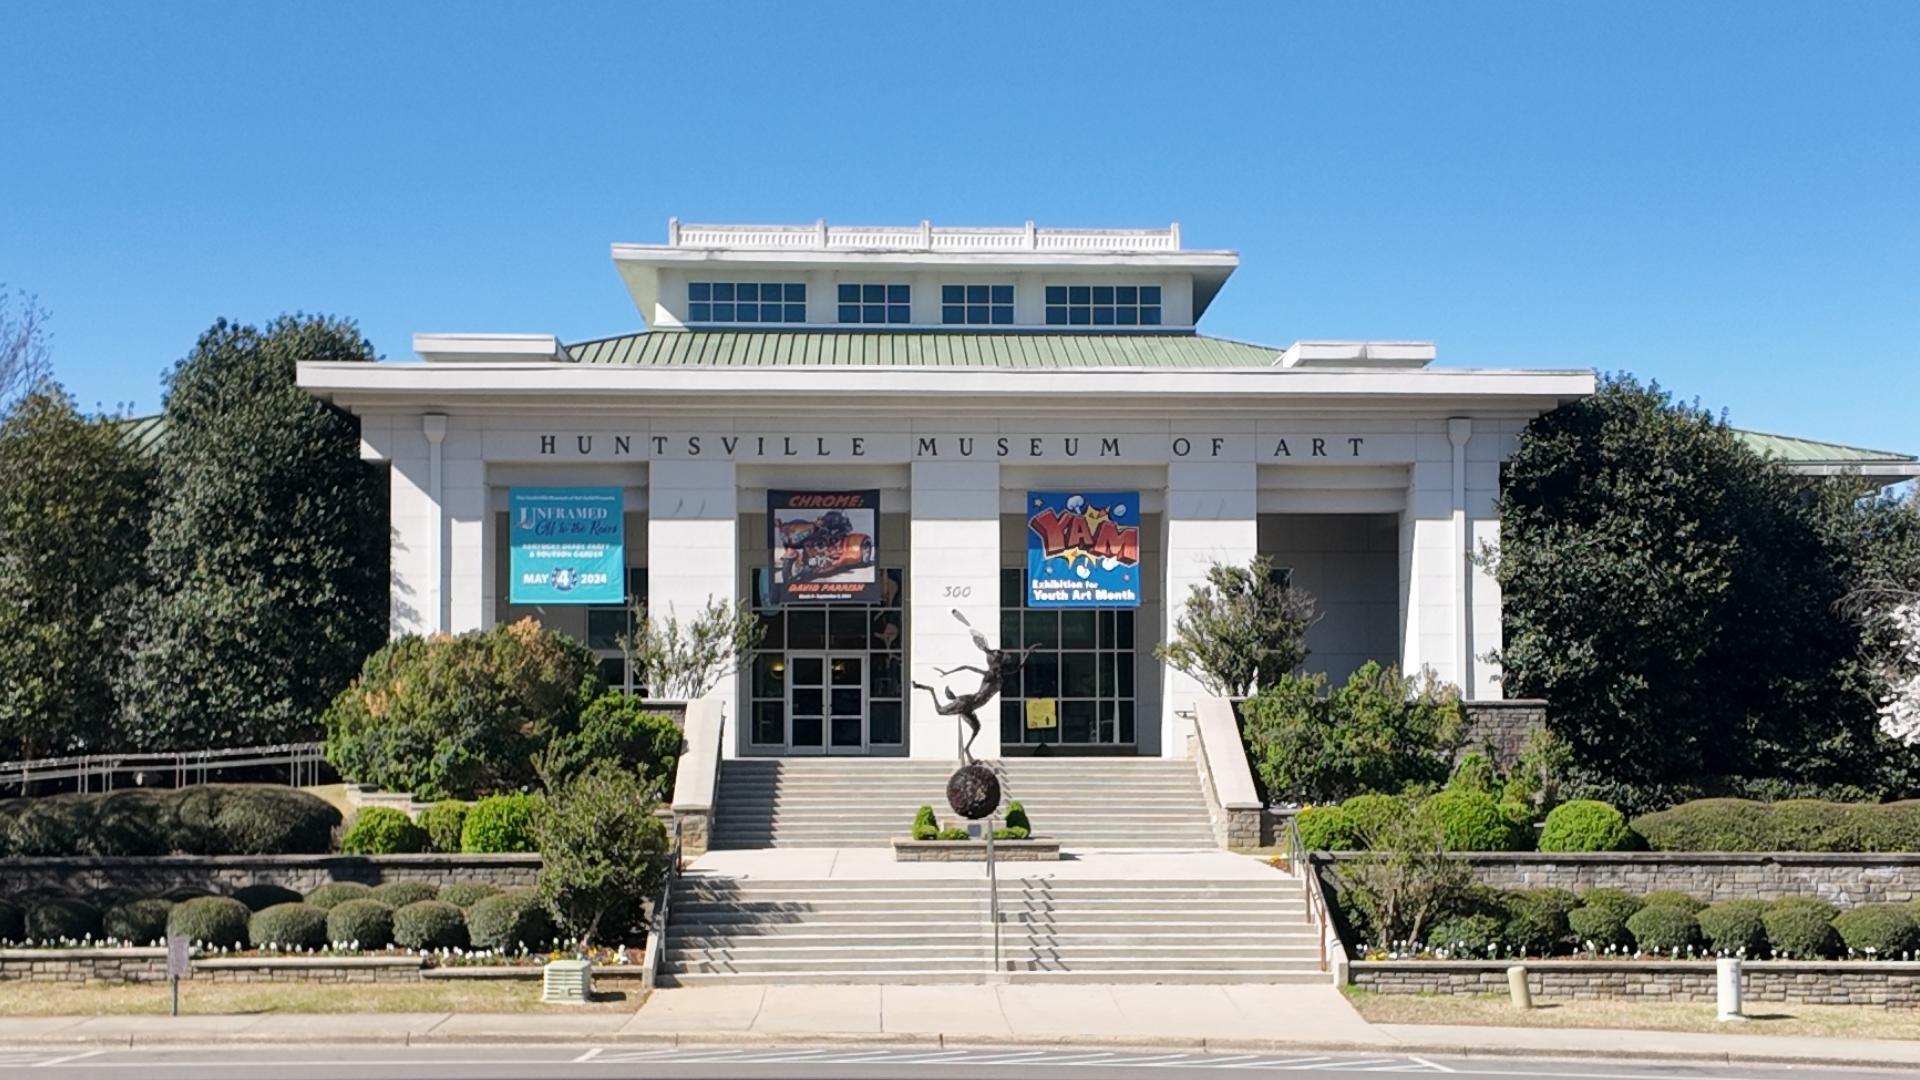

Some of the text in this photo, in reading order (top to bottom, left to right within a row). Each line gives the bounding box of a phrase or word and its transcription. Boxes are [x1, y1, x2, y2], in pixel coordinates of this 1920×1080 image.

[540, 435, 1363, 457] HUNTSVILLE MUSEUM OF ART
[520, 507, 608, 530] UNFRAMED
[1029, 508, 1139, 567] YAM
[523, 569, 608, 588] MAY 4 2024
[1031, 579, 1099, 590] Exhibition for
[788, 583, 865, 593] DAVID PARRISH
[942, 585, 972, 598] 300
[1033, 589, 1136, 601] Youth Art Month
